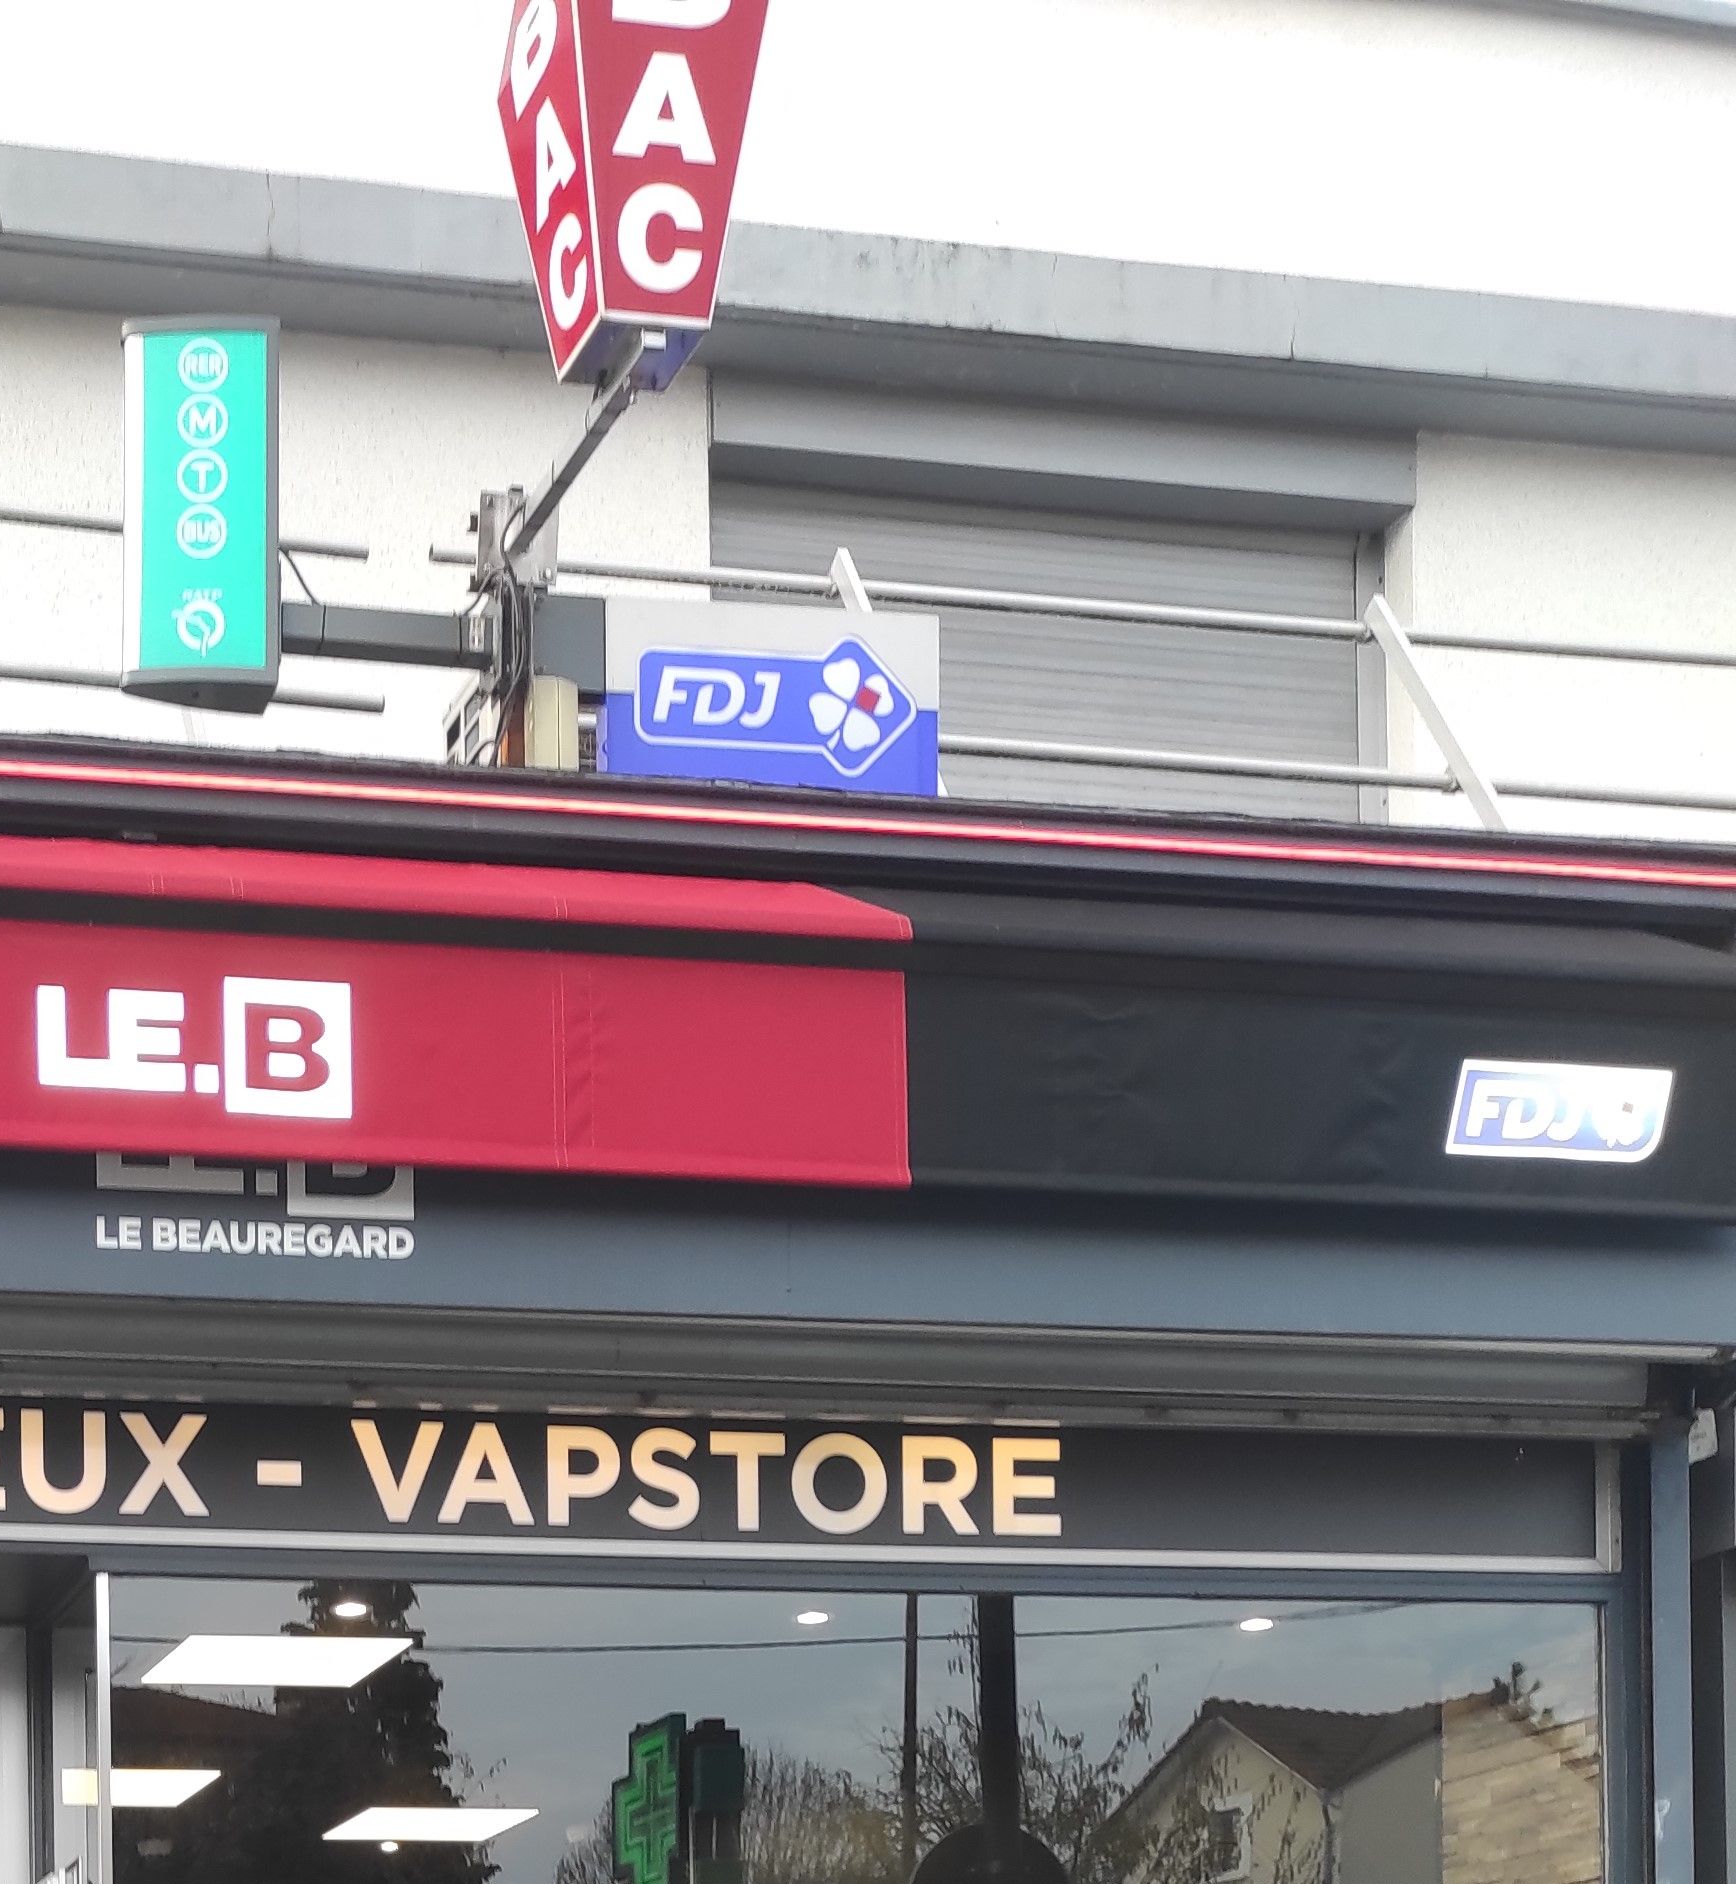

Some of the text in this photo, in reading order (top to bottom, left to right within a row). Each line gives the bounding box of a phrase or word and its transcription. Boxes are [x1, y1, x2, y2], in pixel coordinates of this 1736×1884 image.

[183, 352, 223, 376] RER
[189, 404, 218, 435] M
[191, 461, 215, 493] T
[183, 519, 222, 544] BUS
[653, 664, 780, 730] FDJ
[1465, 1078, 1584, 1142] FDJ
[96, 1215, 415, 1260] LE BEAUREGARD
[350, 1418, 1063, 1537] VAPSTORE
